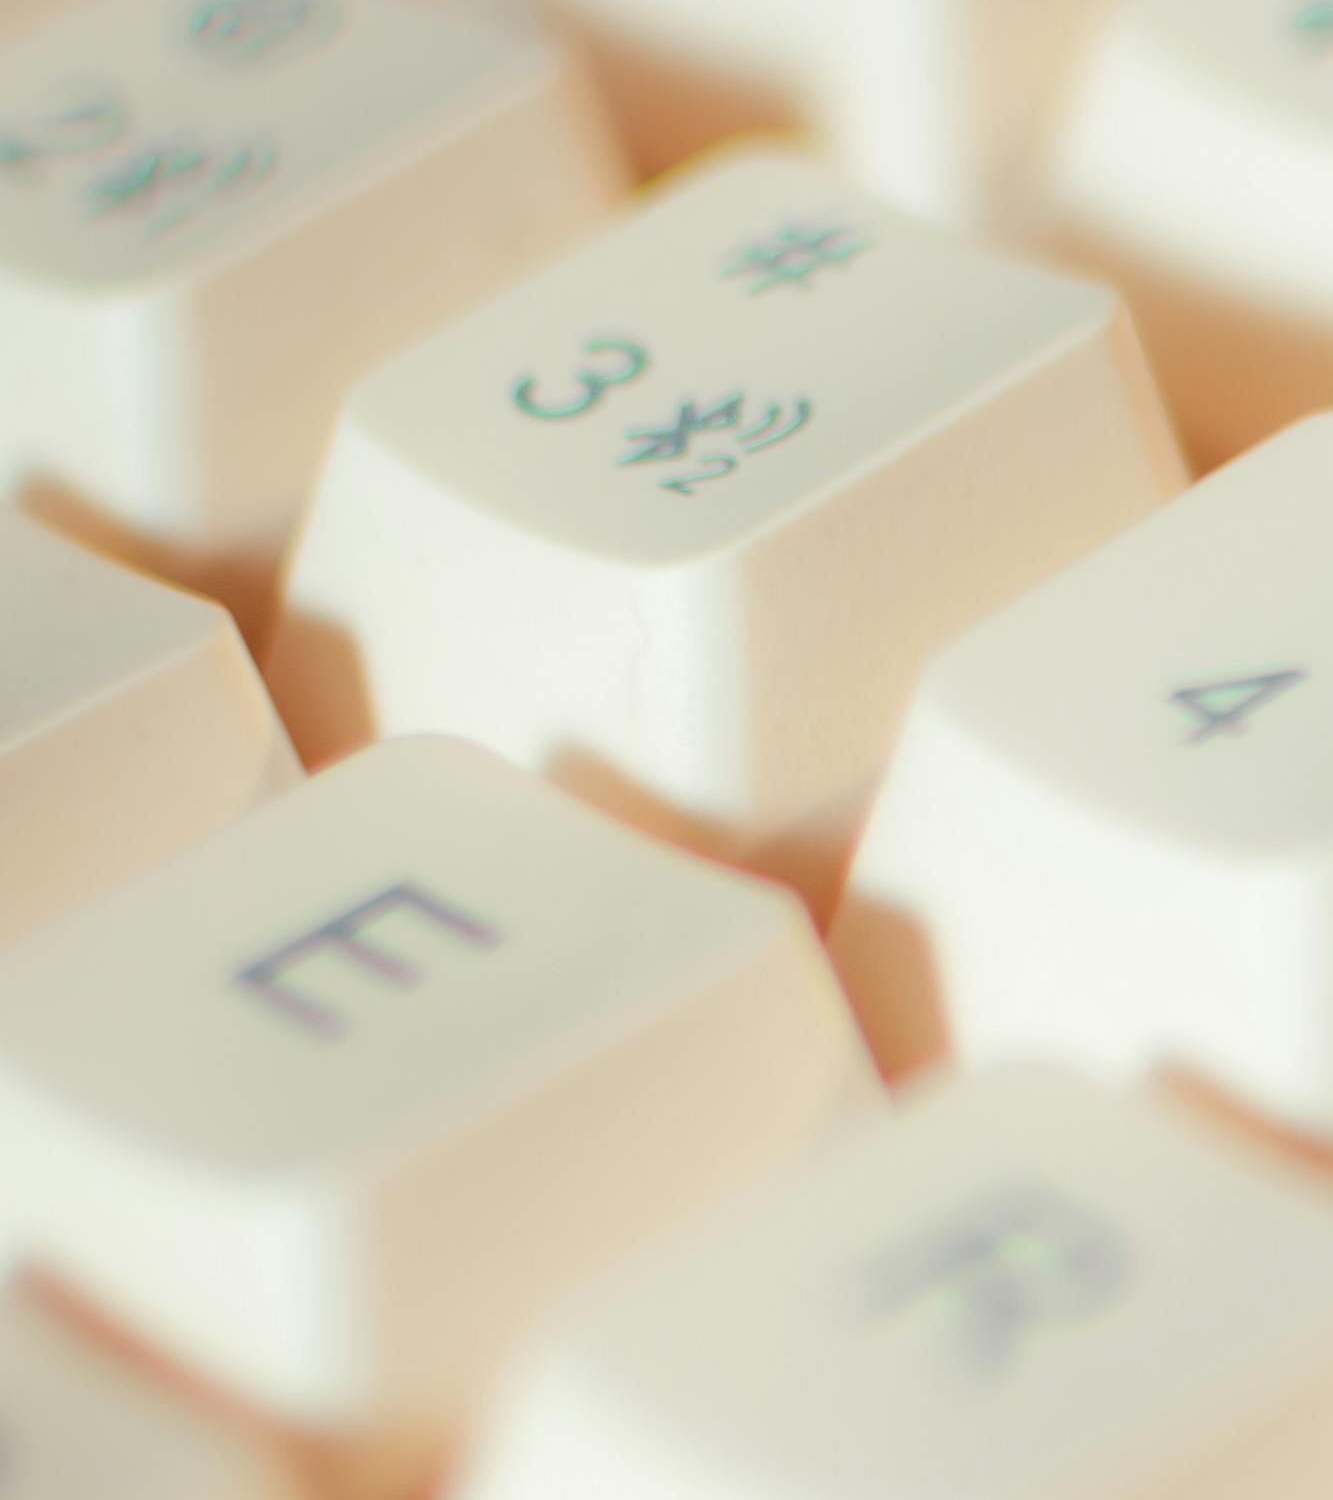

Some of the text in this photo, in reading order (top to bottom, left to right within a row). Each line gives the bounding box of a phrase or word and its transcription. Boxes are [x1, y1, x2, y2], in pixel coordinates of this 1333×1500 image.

[718, 218, 876, 296] #
[511, 335, 650, 420] 3
[1172, 668, 1310, 746] 4
[235, 880, 510, 1042] E
